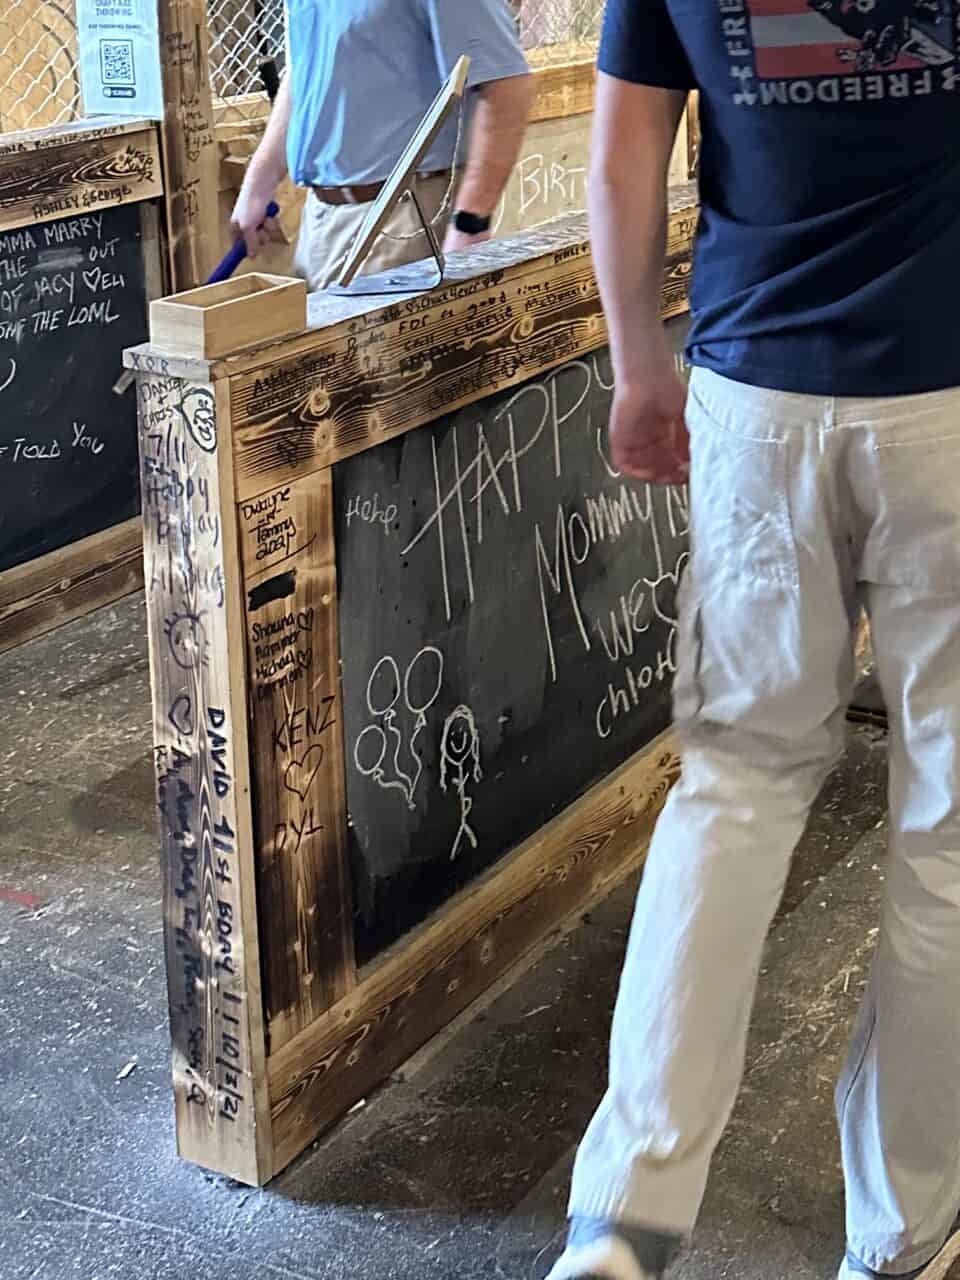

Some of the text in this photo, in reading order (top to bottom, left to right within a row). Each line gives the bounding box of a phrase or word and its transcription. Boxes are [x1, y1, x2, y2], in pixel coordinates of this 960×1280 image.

[759, 70, 933, 105] FREEDOM
[517, 153, 588, 216] BIRT
[44, 213, 104, 246] MARRY
[0, 237, 121, 282] HE OUT
[30, 271, 75, 305] JACY
[31, 298, 121, 334] THE LOML
[205, 707, 233, 800] DAVID
